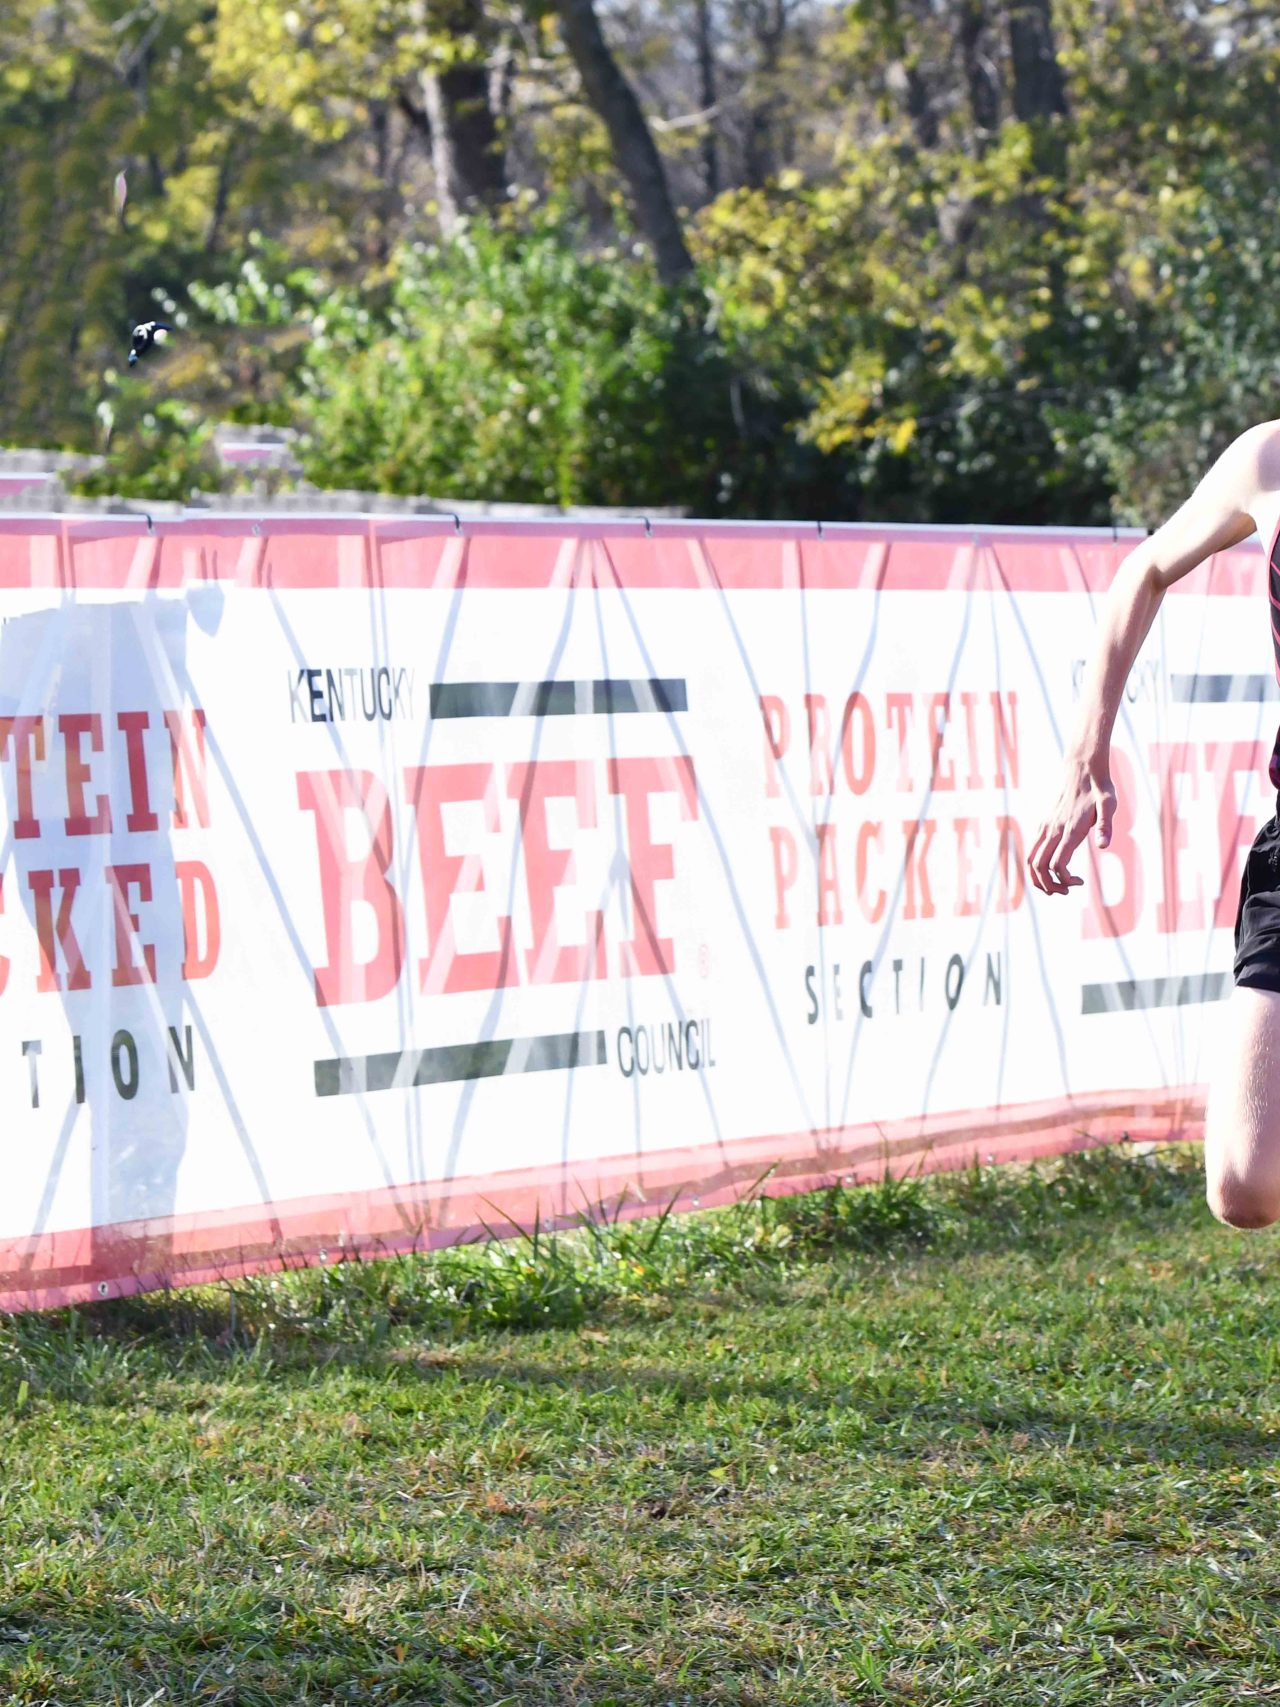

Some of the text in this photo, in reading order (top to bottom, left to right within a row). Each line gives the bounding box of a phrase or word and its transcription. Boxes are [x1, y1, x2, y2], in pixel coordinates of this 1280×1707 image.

[287, 667, 415, 723] KENTUCKY
[760, 691, 1019, 798] PROTEIN
[296, 755, 700, 1007] BEEF
[768, 815, 1025, 929] PACKED
[804, 951, 1002, 1024] SECTION
[22, 1025, 196, 1109] TION
[617, 1020, 716, 1078] COUNCIL
